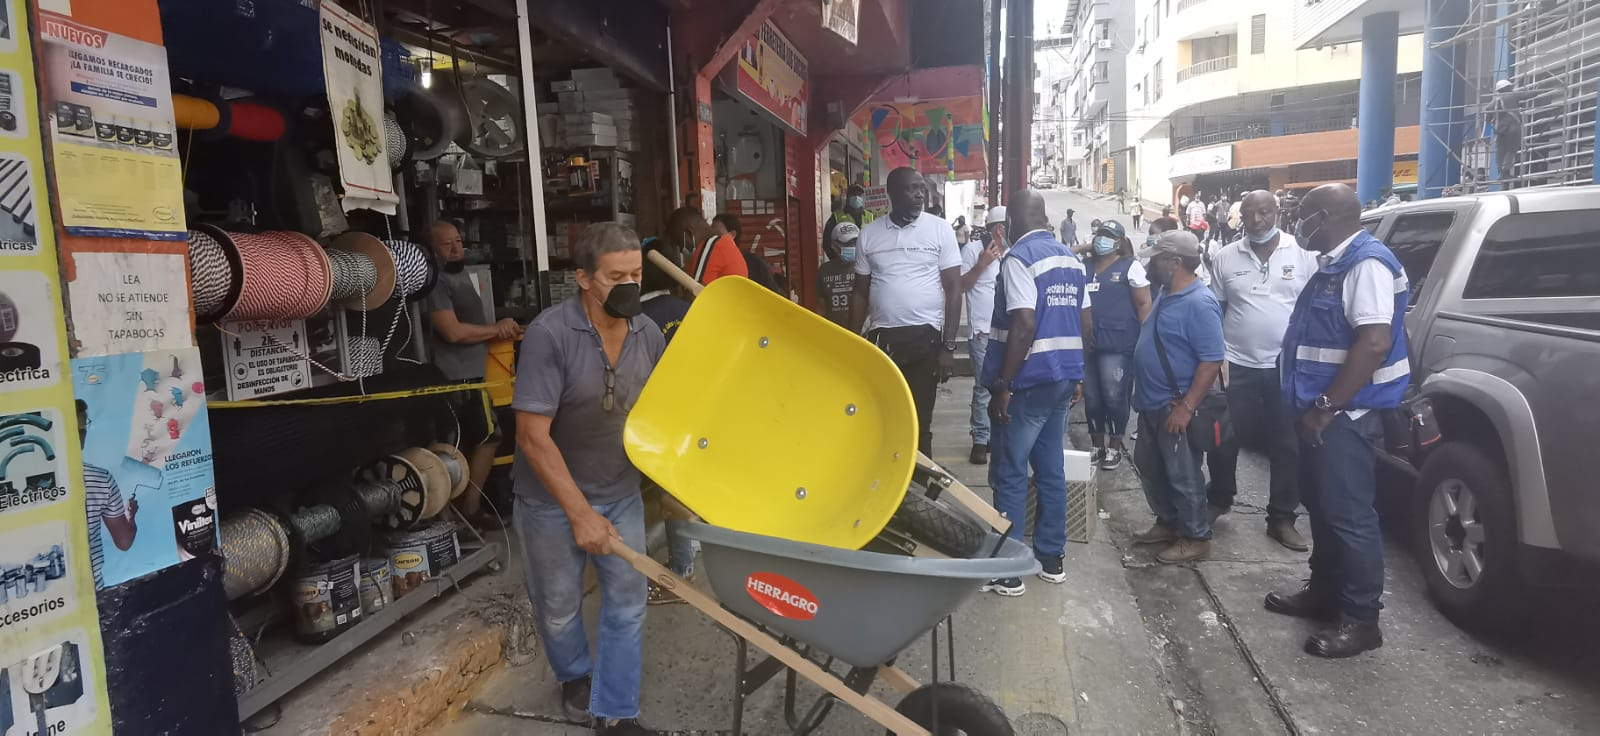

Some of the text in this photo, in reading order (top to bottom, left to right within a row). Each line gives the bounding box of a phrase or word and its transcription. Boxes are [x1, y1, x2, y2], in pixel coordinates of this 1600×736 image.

[322, 18, 333, 34] se
[46, 20, 102, 48] NUEVOS
[83, 62, 114, 76] FAMILIA
[116, 70, 124, 79] SE
[107, 59, 152, 77] RECARGADOS
[122, 274, 141, 285] LEA
[98, 292, 169, 303] NO SE ATIENDE
[831, 295, 848, 307] 83
[126, 311, 143, 321] SIN
[108, 328, 165, 340] TAPABOCAS
[164, 448, 202, 463] LLEGARON
[165, 462, 180, 472] LOS
[747, 576, 818, 615] HERRAGRO
